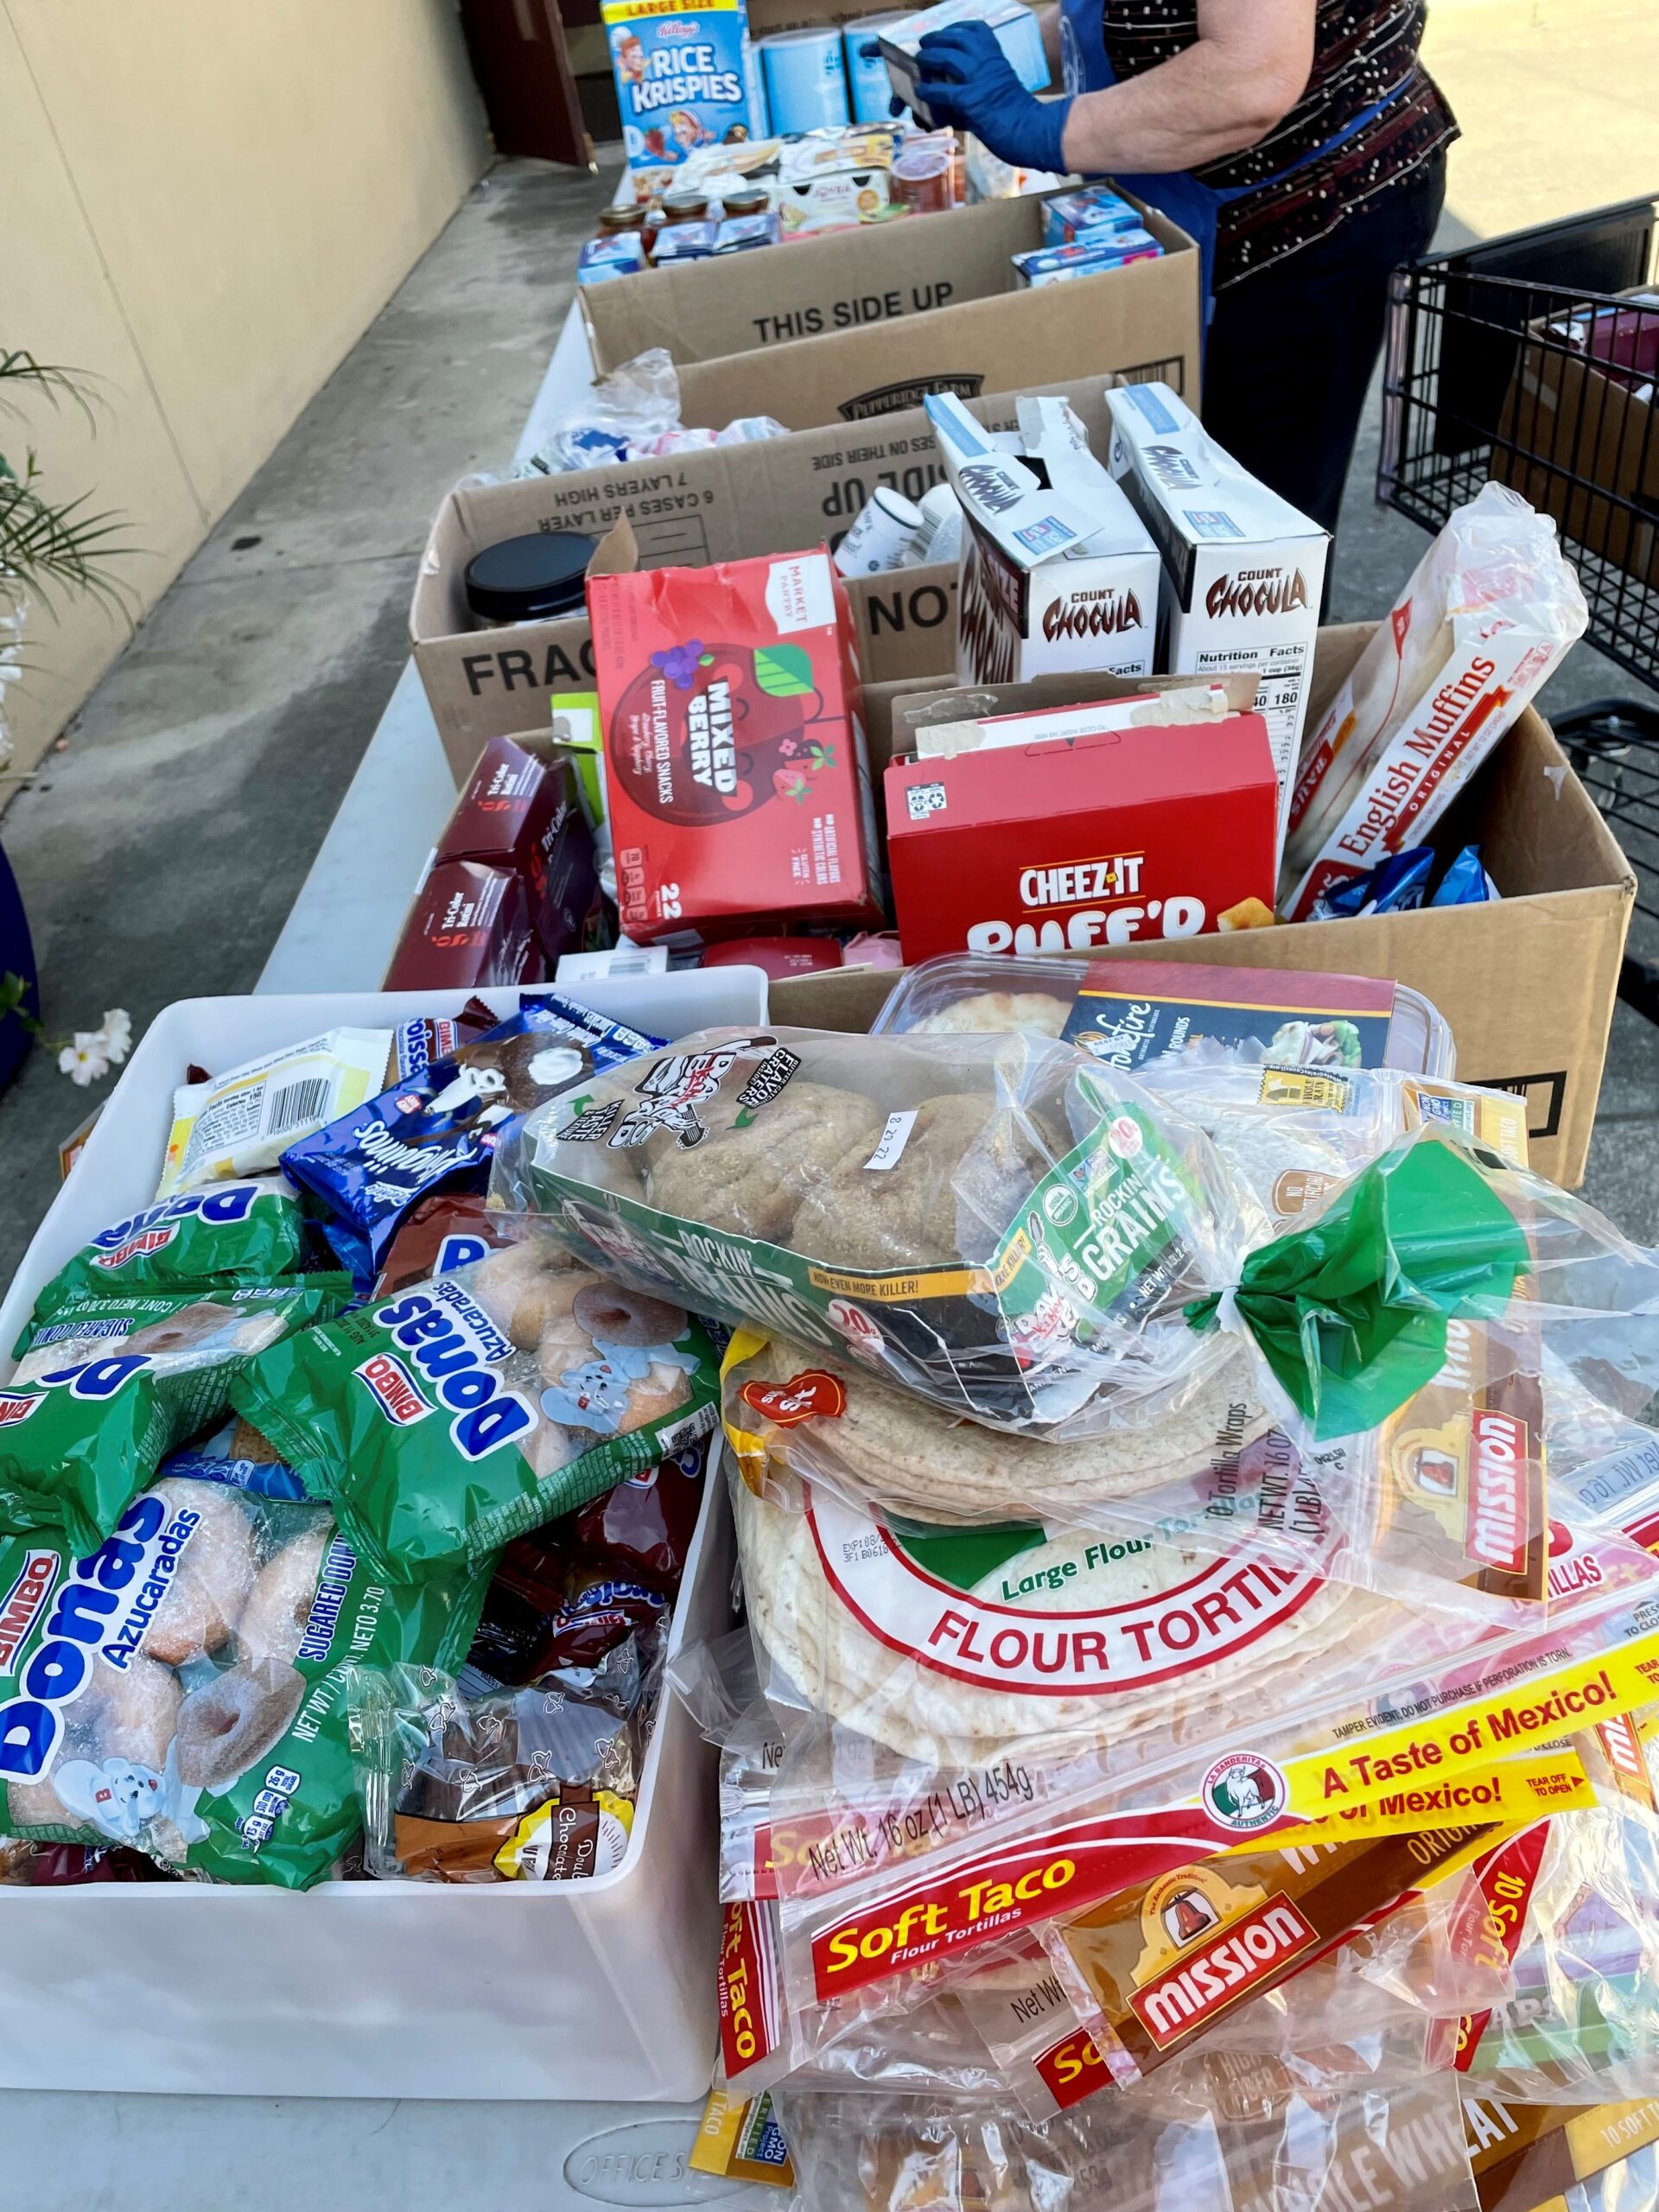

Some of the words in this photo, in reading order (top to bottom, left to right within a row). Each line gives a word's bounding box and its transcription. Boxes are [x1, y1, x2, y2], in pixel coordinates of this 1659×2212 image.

[626, 0, 677, 16] LARGE
[683, 0, 715, 12] SIZE
[652, 46, 715, 78] RICE
[632, 73, 742, 112] KRISPIES
[753, 308, 823, 342] THIS
[834, 292, 901, 327] SIDE
[912, 282, 953, 311] UP
[811, 453, 844, 471] SIDE
[847, 446, 887, 464] THEIR
[890, 440, 910, 456] ON
[602, 474, 674, 499] LAYERS
[677, 473, 689, 486] 7
[555, 486, 601, 507] HIGH
[640, 495, 700, 515] CASES
[703, 491, 715, 504] 6
[822, 478, 867, 517] UP
[537, 511, 597, 531] LAYER
[1238, 567, 1283, 582] COUNT
[780, 575, 794, 620] PANTRY
[789, 566, 807, 623] MARKET
[1071, 588, 1116, 604] COUNT
[1205, 567, 1309, 620] CHOCULA
[1042, 588, 1143, 643] CHOCULA
[1198, 650, 1259, 664] Nutrition
[1269, 645, 1305, 657] Facts
[1198, 664, 1217, 672] About
[1229, 661, 1257, 671] servings
[1270, 658, 1300, 666] container
[1274, 692, 1298, 705] 180
[651, 680, 670, 763] FRUIT-FLAVORED
[708, 682, 737, 793] MIXED
[689, 695, 714, 787] BERRY
[1337, 757, 1422, 858] English
[1405, 655, 1497, 760] Muffins
[487, 763, 510, 797] Tri-Color
[502, 774, 518, 796] Rotini
[656, 764, 674, 804] SNACKS
[1409, 730, 1472, 812] ORIGINAL
[542, 800, 569, 852] Tri-Color
[800, 854, 810, 879] GLUTEN
[829, 858, 841, 883] FLAVORS
[442, 892, 465, 931] Tri-Color
[457, 903, 475, 929] Rotini
[660, 883, 683, 919] 22
[1169, 1016, 1191, 1049] ROUNDS
[739, 1048, 786, 1104] CRATERS
[746, 1054, 794, 1108] FLAVOR
[749, 1061, 768, 1085] INSIDE!
[1421, 1093, 1432, 1113] NON
[1433, 1099, 1441, 1116] GMO
[559, 1116, 588, 1138] TEXTURE
[569, 1108, 608, 1140] TASTE
[585, 1103, 620, 1140] KILLER
[1501, 1118, 1518, 1142] TACO
[874, 1147, 890, 1160] 22
[1046, 1191, 1065, 1209] USDA
[1091, 1173, 1144, 1225] ROCKIN
[1286, 1186, 1302, 1197] NO
[1082, 1166, 1187, 1281] GRAINS
[98, 1225, 176, 1268] BIMBO
[677, 1229, 755, 1279] ROCKIN'
[813, 1273, 830, 1286] NOW
[830, 1276, 852, 1290] EVEN
[852, 1279, 878, 1295] MORE
[879, 1280, 919, 1296] KILLER!
[1139, 1277, 1160, 1299] NET
[110, 1299, 139, 1312] NETO
[140, 1300, 175, 1313] CONT.
[433, 1281, 512, 1363] Azucaradas
[73, 1319, 134, 1338] SUGARED
[349, 1331, 366, 1345] AUG
[364, 1359, 425, 1421] BIMBO
[378, 1294, 530, 1457] Donas
[1228, 1402, 1248, 1450] Wraps
[1215, 1438, 1241, 1495] Tortilla
[1264, 1450, 1291, 1468] 16
[1262, 1470, 1290, 1504] WT.
[1474, 1415, 1516, 1565] mission
[1208, 1497, 1233, 1522] 10
[1258, 1502, 1285, 1530] NET
[842, 1541, 863, 1553] EXP:
[843, 1552, 859, 1563] 3F1
[1001, 1560, 1077, 1603] Large
[1084, 1536, 1152, 1571] Flour
[103, 1509, 200, 1669] Azucaradas
[360, 1583, 386, 1614] 3.70
[0, 1497, 166, 1775] Donas
[300, 1581, 347, 1662] SUGARED
[351, 1612, 378, 1652] NETO
[1624, 1624, 1639, 1637] TO
[928, 1610, 1110, 1673] FLOUR
[308, 1688, 335, 1715] WT
[1332, 1719, 1365, 1739] TAMPER
[1365, 1709, 1402, 1731] EVIDENT;
[1402, 1707, 1414, 1719] DO
[1414, 1700, 1432, 1717] NOT
[1431, 1684, 1475, 1712] PURCHASE
[1482, 1659, 1535, 1691] PERFORATION
[1535, 1657, 1546, 1670] IS
[1546, 1647, 1573, 1668] TORN.
[291, 1711, 325, 1744] NET
[1323, 1766, 1348, 1799] A
[1350, 1729, 1442, 1786] Taste
[1449, 1720, 1484, 1756] of
[1484, 1669, 1617, 1744] Mexico!
[1543, 1738, 1572, 1751] CLOSE
[286, 1775, 297, 1792] SUGARS
[1208, 1773, 1217, 1784] LA
[1215, 1755, 1262, 1775] BANDERITA
[1526, 1776, 1549, 1788] TEAR
[1550, 1773, 1567, 1784] OFF
[247, 1827, 257, 1837] 13
[269, 1775, 280, 1786] 26
[1381, 1777, 1502, 1816] Mexico!
[1535, 1787, 1548, 1797] TO
[1550, 1783, 1573, 1795] OPEN
[808, 1840, 844, 1881] Net
[846, 1824, 878, 1864] Wt.
[879, 1818, 903, 1851] 16
[906, 1815, 930, 1840] oz
[931, 1802, 946, 1839] (1
[947, 1780, 985, 1821] LB)
[985, 1763, 1034, 1806] 454g
[1230, 1805, 1280, 1827] AUTHENTIC
[551, 1807, 575, 1880] Chocolate
[1150, 1877, 1175, 1904] Authentic
[1175, 1872, 1205, 1884] Tradition
[1494, 1872, 1527, 1899] 10
[826, 1904, 948, 1973] Soft
[958, 1859, 1077, 1919] Taco
[1149, 1904, 1158, 1916] The
[1465, 1909, 1480, 1936] Flour
[890, 1937, 938, 1966] Flour
[945, 1906, 1022, 1944] Tortillas
[1474, 1899, 1518, 1972] Soft
[719, 1956, 729, 2018] Tortillas
[1144, 1906, 1306, 2035] mission
[728, 1958, 756, 2058] Taco
[1011, 1990, 1040, 2024] Net
[704, 2102, 728, 2135] TACO
[747, 2098, 771, 2156] ERIFIED
[1599, 2126, 1621, 2150] 10
[1621, 2111, 1648, 2140] SOFT
[757, 2126, 773, 2158] Project
[765, 2126, 781, 2159] GMO
[580, 2152, 671, 2185] OFFICE
